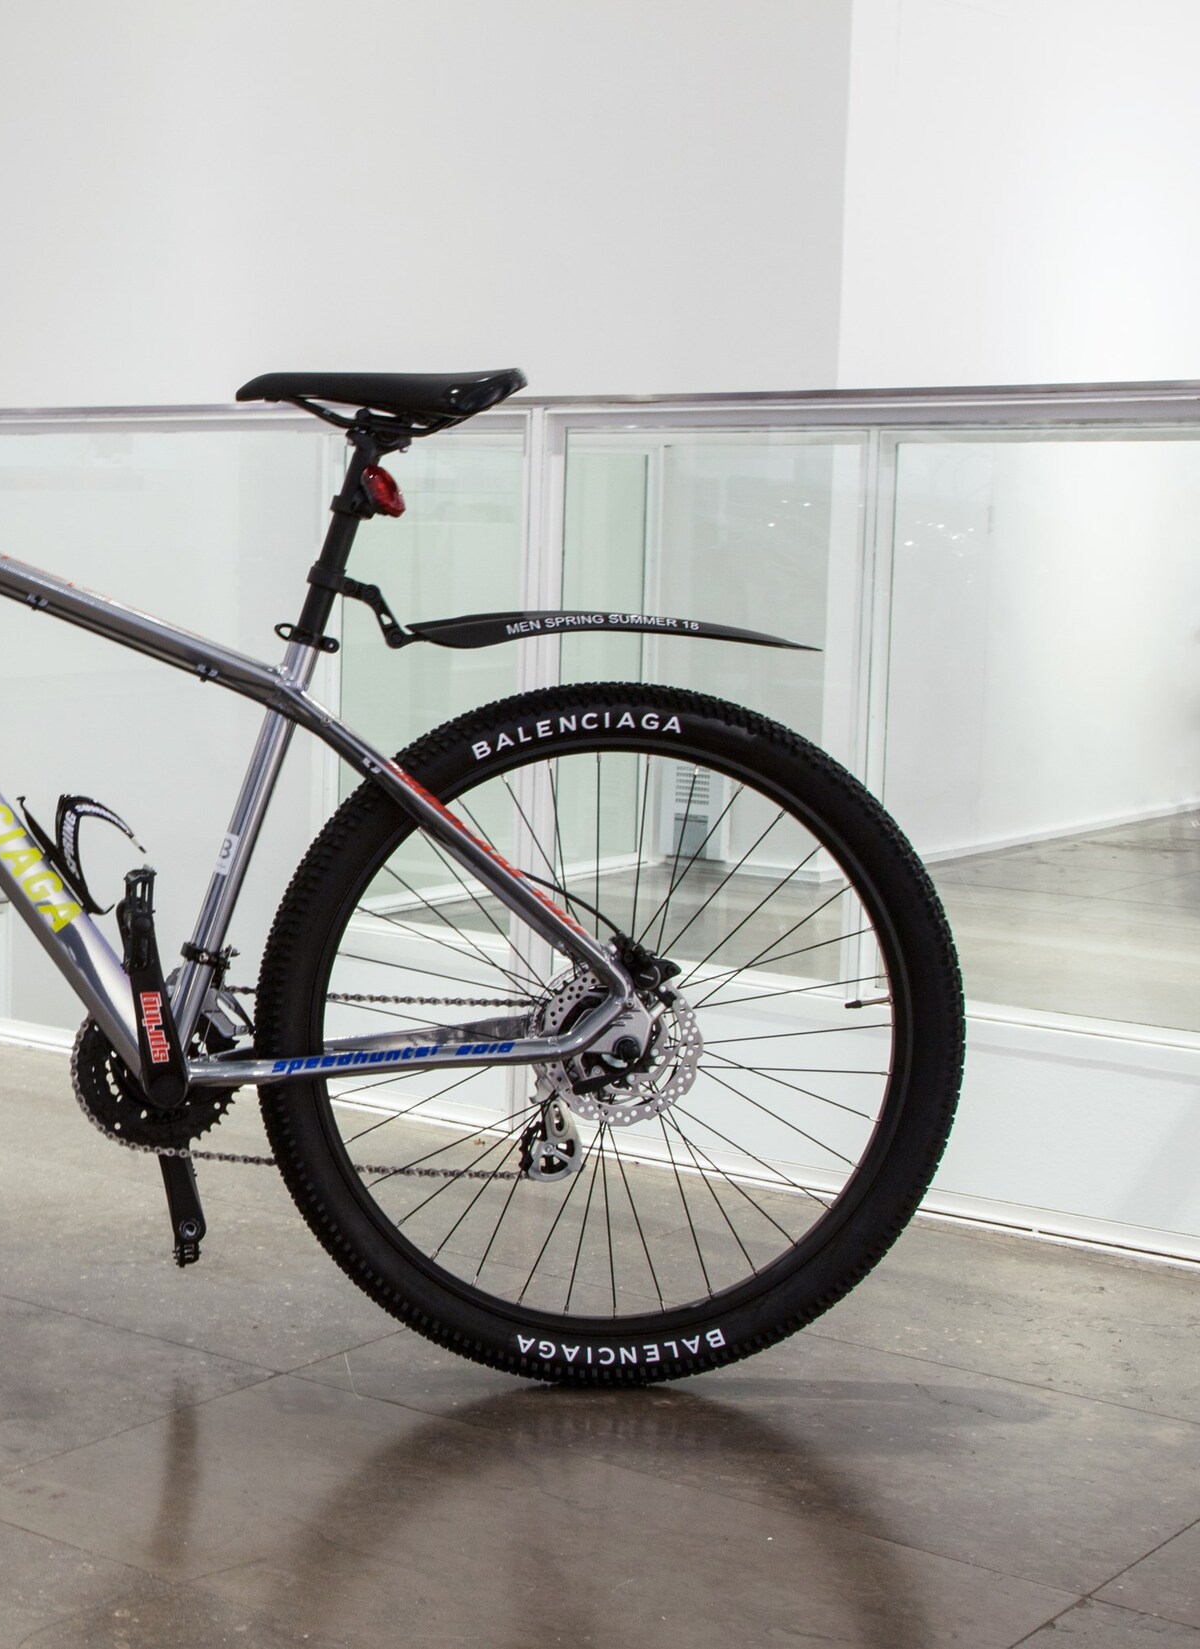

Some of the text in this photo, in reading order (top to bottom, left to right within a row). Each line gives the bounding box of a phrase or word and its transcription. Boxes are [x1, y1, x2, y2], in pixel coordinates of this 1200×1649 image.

[506, 614, 700, 635] MEN SPRING SUMMER 18
[472, 711, 682, 760] BALENCIAGA
[517, 1328, 726, 1365] BALENCIAGA
